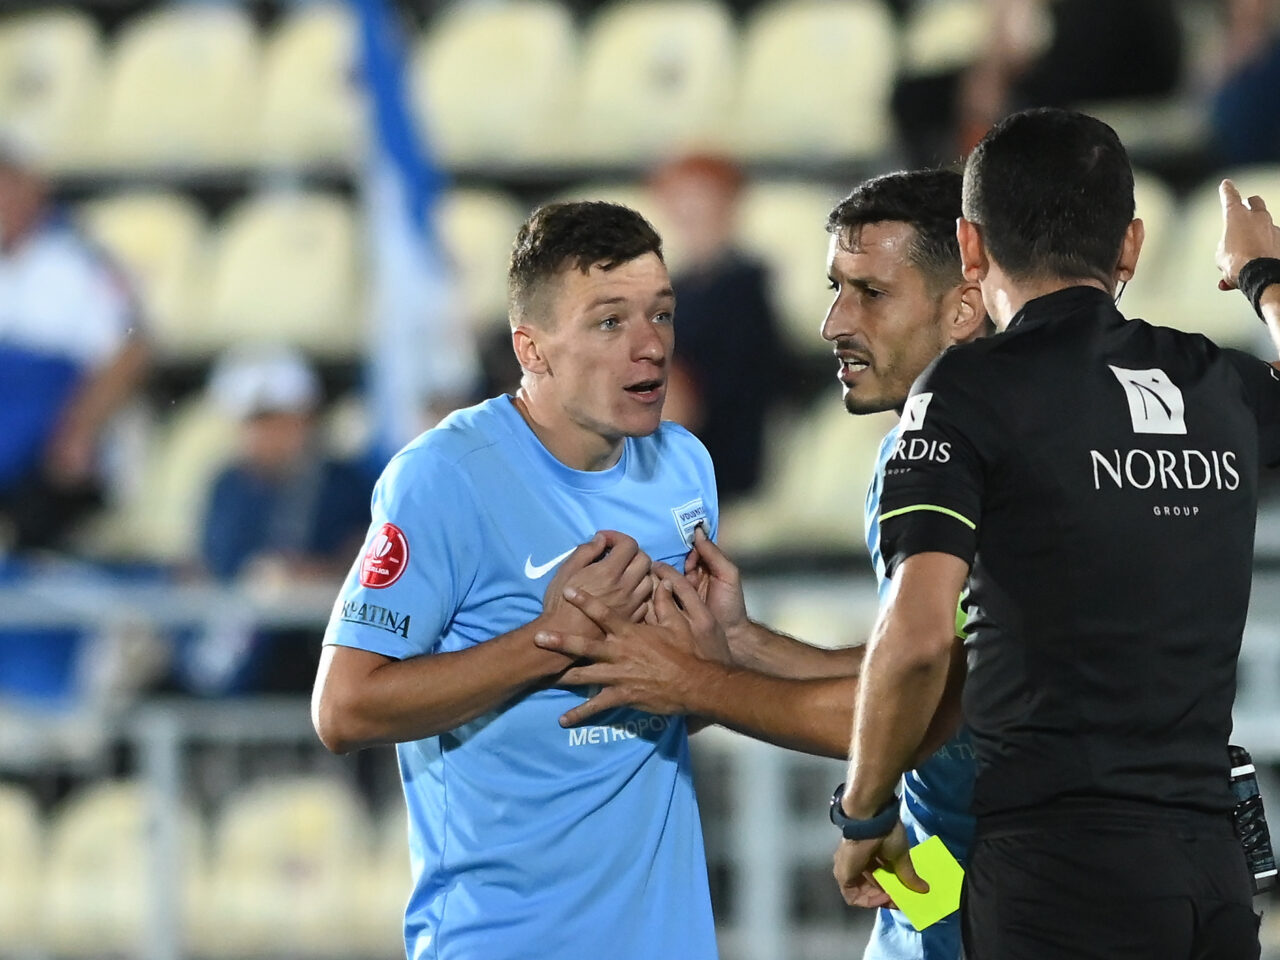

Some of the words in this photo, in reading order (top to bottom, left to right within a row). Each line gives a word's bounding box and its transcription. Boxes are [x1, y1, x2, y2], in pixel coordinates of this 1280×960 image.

[892, 439, 952, 463] RDIS
[1090, 449, 1240, 491] NORDIS
[1153, 505, 1199, 517] GROUP
